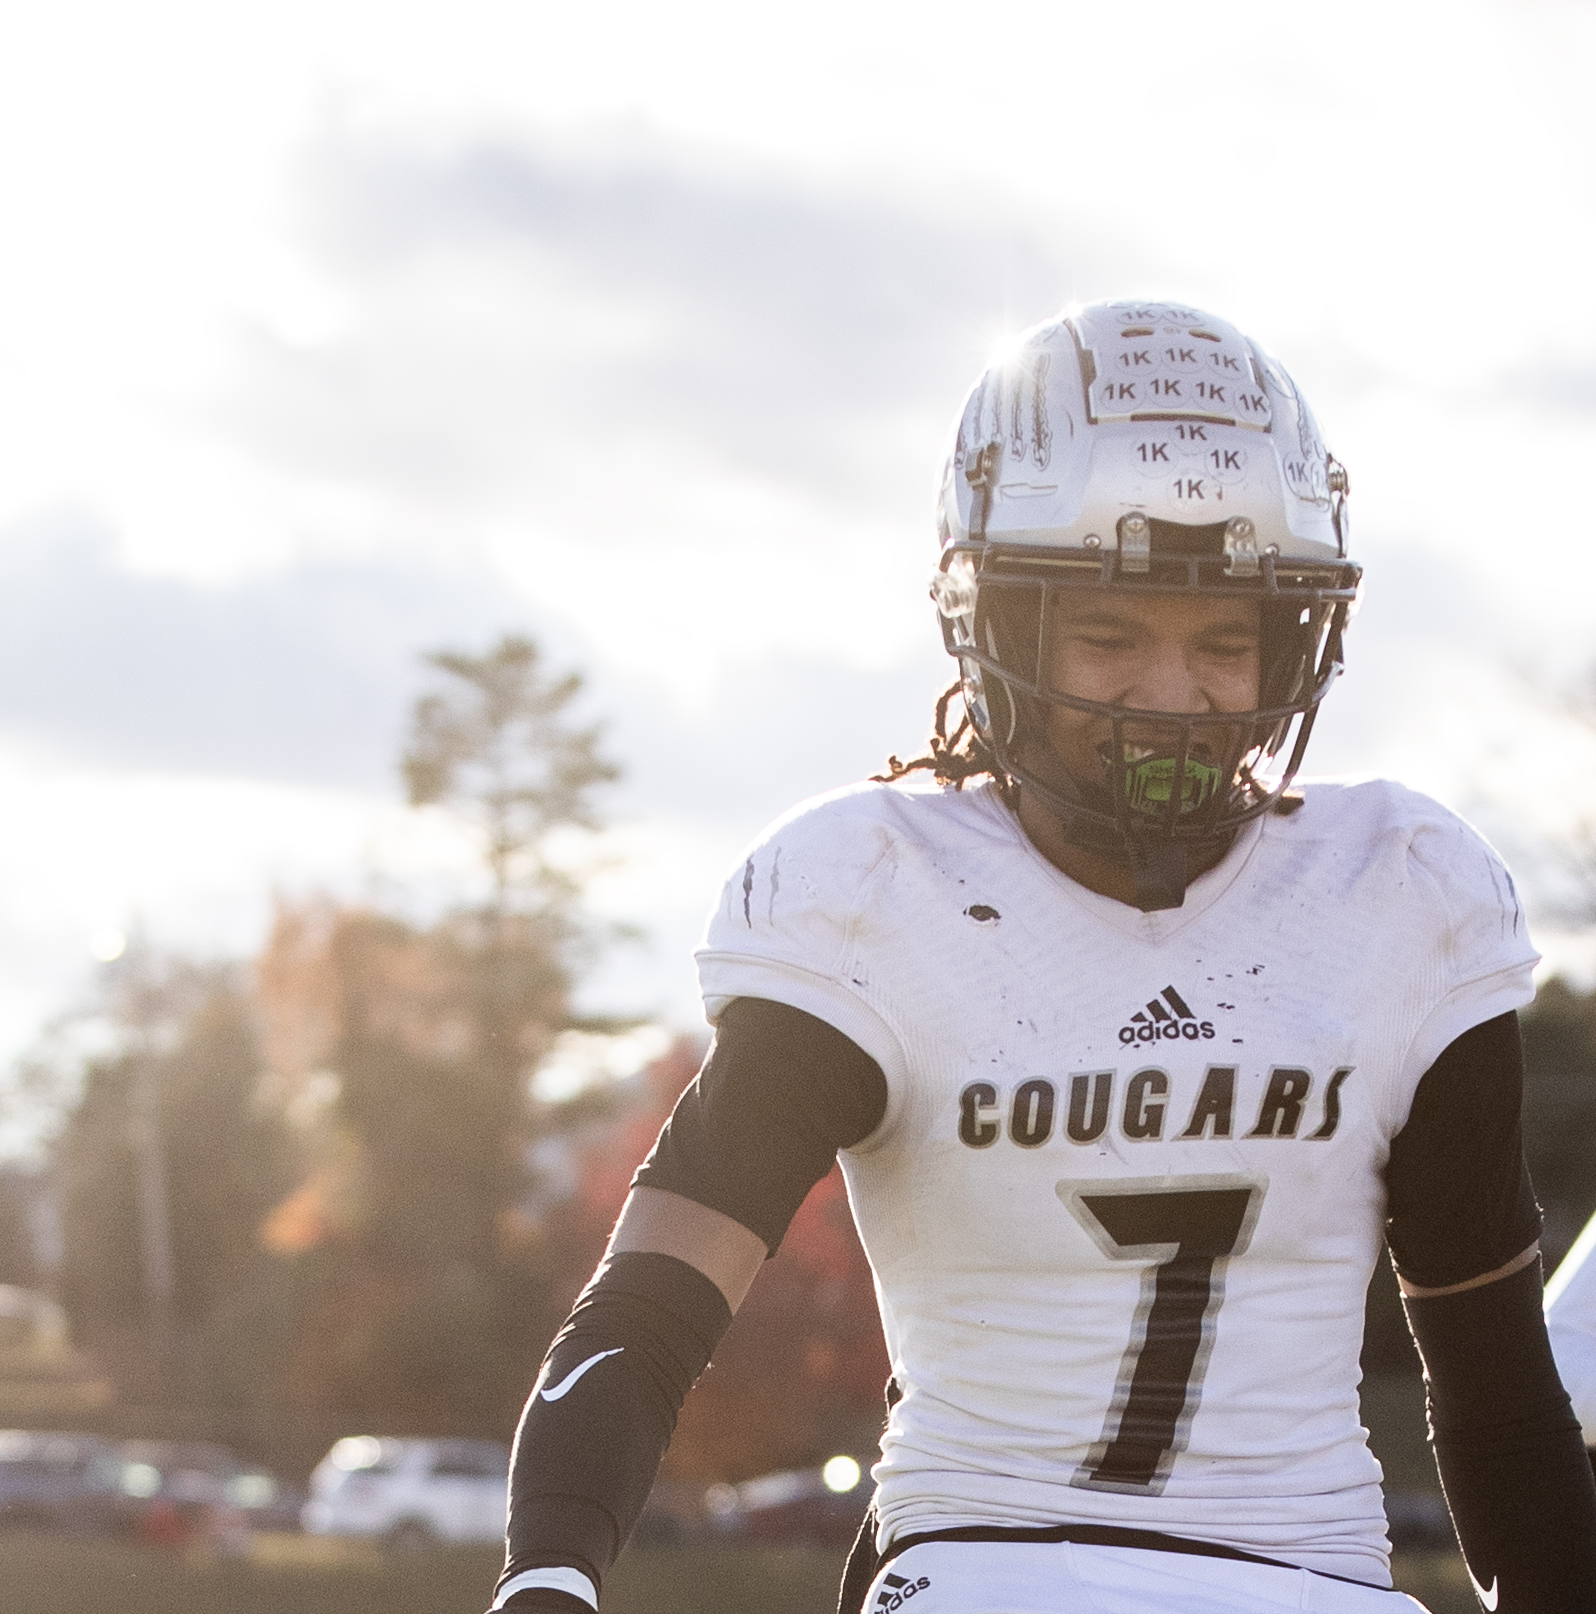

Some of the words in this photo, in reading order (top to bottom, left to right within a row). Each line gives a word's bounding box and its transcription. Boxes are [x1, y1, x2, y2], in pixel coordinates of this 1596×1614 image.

[1120, 350, 1153, 366] 1K
[1166, 348, 1197, 364] 1K
[1210, 352, 1240, 372] 1K
[1105, 382, 1136, 400] 1K
[1151, 379, 1182, 396] 1K
[1196, 381, 1226, 403] 1K
[1239, 393, 1268, 413] 1K
[1176, 424, 1208, 441] 1K
[1137, 443, 1170, 462] 1K
[1211, 450, 1242, 470] 1K
[1288, 462, 1309, 483] 1K
[1174, 479, 1205, 499] 1K
[1119, 1016, 1216, 1044] adidas
[957, 1065, 1357, 1150] COUGARS
[1055, 1173, 1271, 1498] 7
